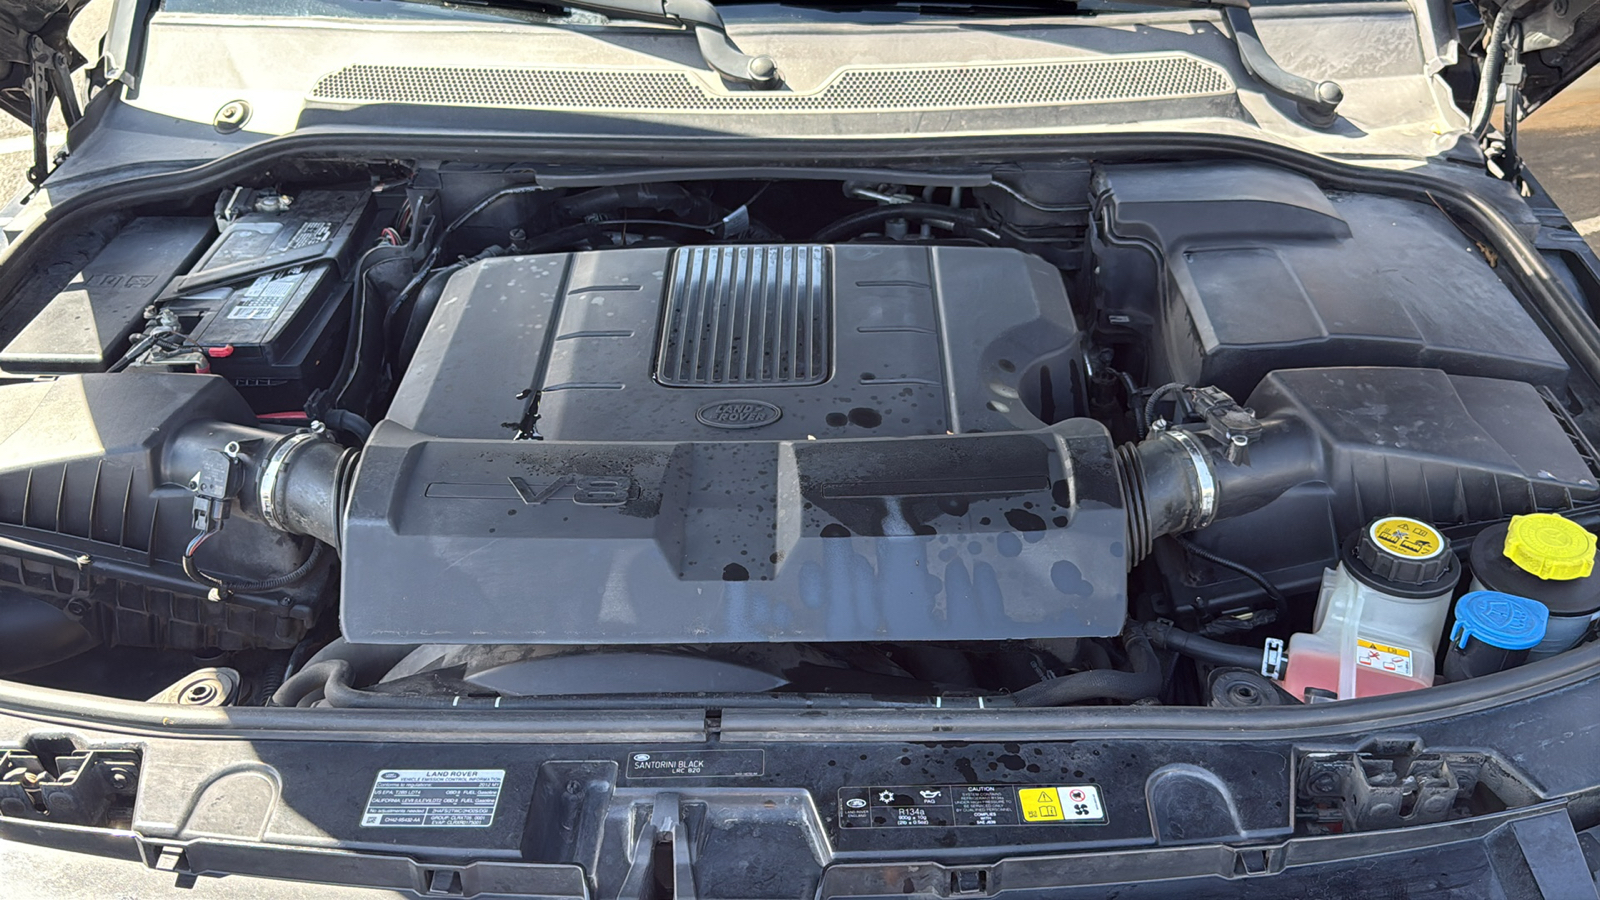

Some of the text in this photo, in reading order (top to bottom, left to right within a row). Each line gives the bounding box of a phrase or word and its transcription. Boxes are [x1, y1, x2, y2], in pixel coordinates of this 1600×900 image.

[716, 404, 753, 413] LAND
[719, 412, 766, 421] ROVER
[507, 475, 632, 506] V8
[678, 760, 704, 768] BLACK
[898, 808, 925, 816] R134a
